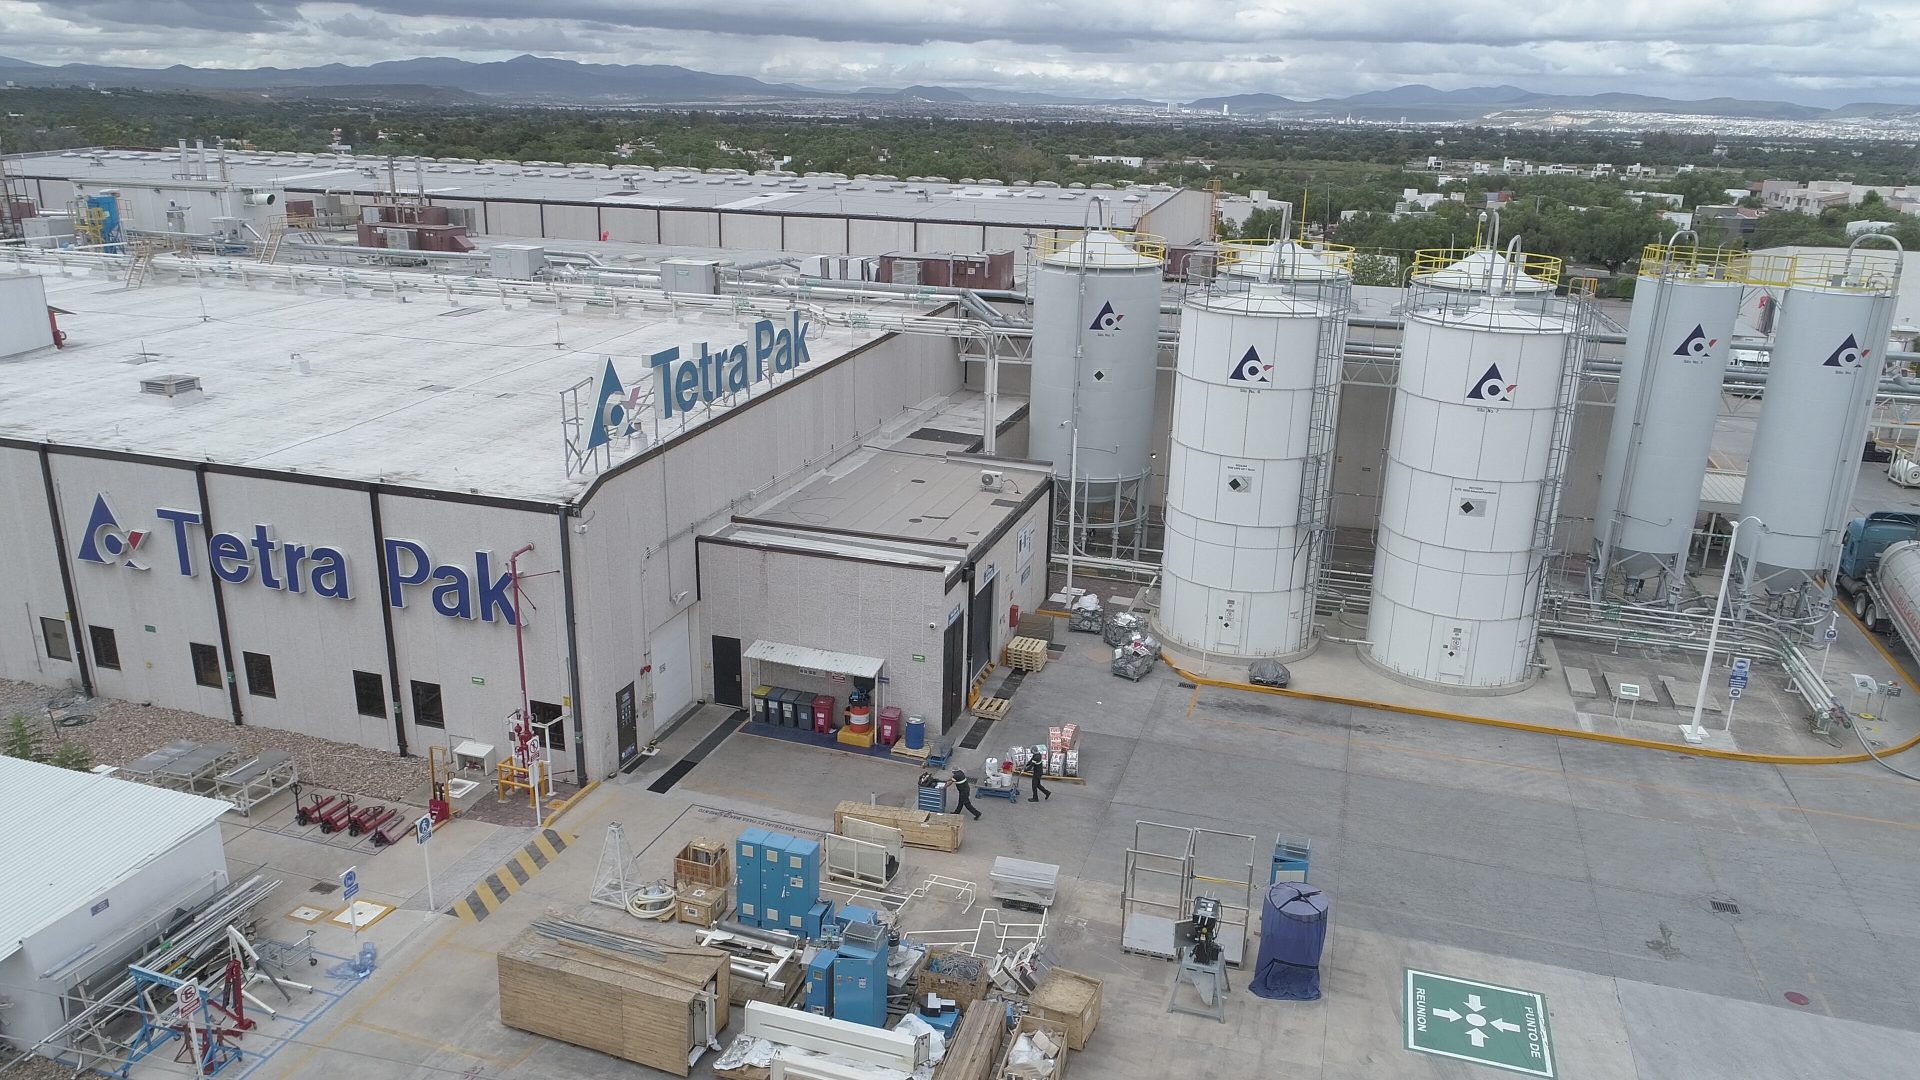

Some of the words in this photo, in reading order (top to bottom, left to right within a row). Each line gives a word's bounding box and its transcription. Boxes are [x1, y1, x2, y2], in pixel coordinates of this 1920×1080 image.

[644, 342, 748, 419] Tetra
[752, 310, 811, 383] Pak
[156, 507, 353, 600] Tetra
[384, 538, 526, 627] Pak
[1416, 988, 1427, 1032] REUNION
[1524, 1006, 1538, 1041] PUNTO
[1529, 1042, 1541, 1058] DE
